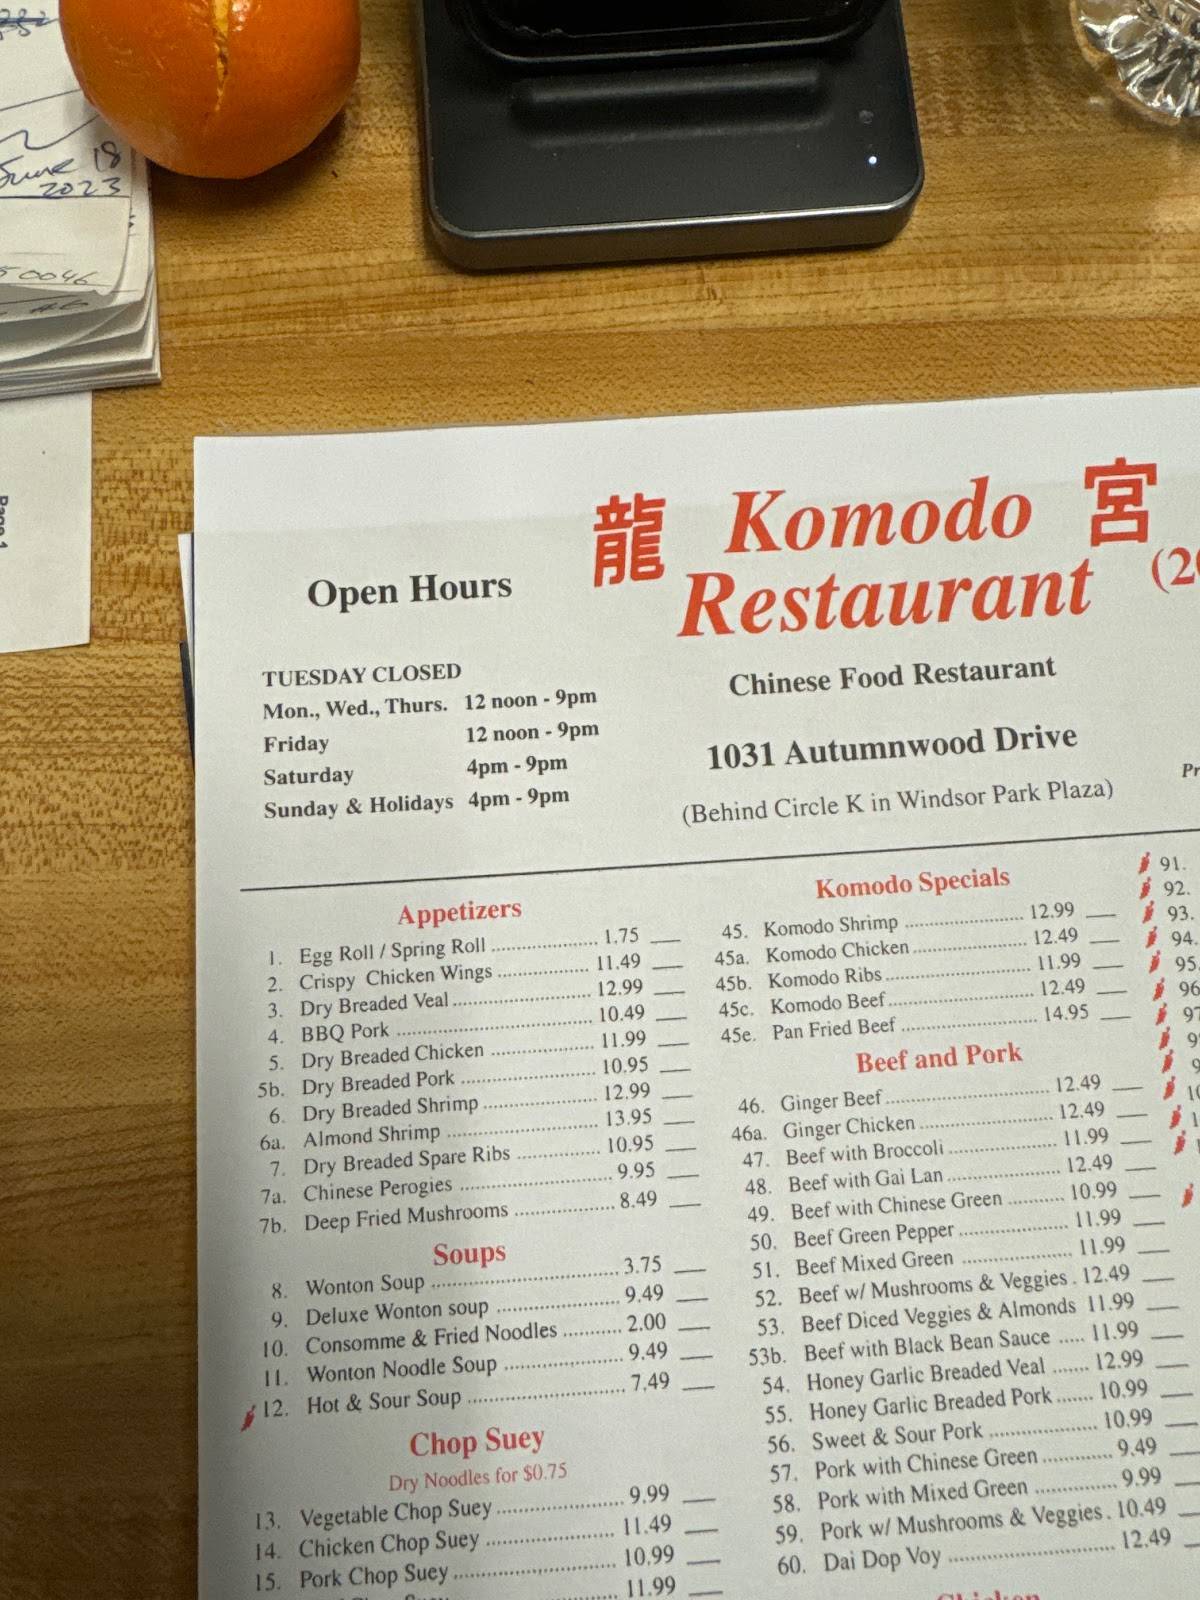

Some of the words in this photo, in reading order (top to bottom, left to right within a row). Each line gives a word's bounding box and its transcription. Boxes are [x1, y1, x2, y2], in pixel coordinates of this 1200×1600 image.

[40, 177, 121, 197] 2023
[723, 475, 1032, 553] Komodo
[1084, 457, 1157, 547] 宮
[593, 492, 666, 588] 龍
[1151, 547, 1200, 594] (2
[308, 579, 398, 614] Open
[409, 574, 512, 602] Hours
[677, 558, 1094, 637] Restaurant
[262, 667, 366, 687] TUESDAY
[372, 663, 461, 683] CLOSED
[729, 672, 831, 696] Chinese
[839, 664, 904, 690] Food
[912, 656, 1057, 685] Restaurant
[263, 703, 320, 721] Mon.,
[326, 699, 380, 718] Wed.,
[384, 698, 447, 714] Thurs.
[465, 694, 486, 710] 12
[491, 695, 538, 709] noon
[555, 689, 597, 709] 9pm
[264, 735, 329, 755] Friday
[467, 726, 488, 743] 12
[493, 728, 540, 742] noon
[557, 721, 599, 741] 9pm
[707, 742, 775, 770] 1031
[784, 728, 986, 765] Autumnwood
[993, 727, 1078, 752] Drive
[264, 766, 354, 786] Saturday
[467, 759, 509, 779] 4pm
[526, 755, 568, 776] 9pm
[265, 800, 338, 820] Sunday
[346, 798, 363, 814] &
[370, 795, 454, 814] Holidays
[468, 791, 510, 812] 4pm
[527, 788, 570, 808] 9pm
[682, 800, 768, 828] (Behind
[774, 796, 839, 818] Circle
[846, 794, 864, 813] K
[871, 793, 891, 812] in
[896, 788, 986, 809] Windsor
[992, 783, 1041, 804] Park
[1047, 779, 1113, 800] Plaza)
[816, 875, 912, 899] Komodo
[918, 867, 1010, 896] Specials
[1160, 856, 1186, 871] 91.
[1164, 881, 1190, 896] 92.
[398, 900, 522, 929] Appetizers
[722, 924, 748, 939] 45.
[764, 918, 834, 938] Komodo
[839, 915, 898, 933] Shrimp
[1031, 902, 1074, 919] 12.99
[1167, 905, 1194, 922] 93.
[270, 951, 282, 965] 1.
[300, 948, 333, 967] Egg
[340, 944, 373, 962] Roll
[380, 943, 386, 959] /
[391, 941, 446, 962] Spring
[452, 937, 485, 954] Roll
[606, 927, 638, 944] 1.75
[715, 950, 749, 966] 45a.
[766, 944, 837, 963] Komodo
[841, 940, 909, 958] Chicken
[1034, 927, 1078, 945] 12.49
[1171, 931, 1198, 947] 94.
[268, 976, 283, 993] 2.
[299, 973, 355, 992] Crispy
[366, 968, 435, 986] Chicken
[440, 964, 492, 983] Wings
[598, 953, 641, 971] 11.49
[268, 1029, 283, 1044] 4.
[302, 1024, 344, 1043] BBQ
[351, 1021, 389, 1039] Pork
[600, 1004, 645, 1022] 10.49
[269, 1055, 284, 1071] 5.
[302, 1053, 334, 1072] Dry
[341, 1046, 409, 1066] Breaded
[414, 1043, 484, 1061] Chicken
[603, 1030, 646, 1048] 11.99
[856, 1049, 908, 1073] Beef
[915, 1046, 958, 1069] and
[965, 1042, 1023, 1065] Pork
[260, 1135, 285, 1150] 6a.
[304, 1127, 373, 1147] Almond
[378, 1124, 440, 1143] Shrimp
[607, 1108, 652, 1126] 13.95
[731, 1125, 767, 1141] 46a.
[783, 1122, 841, 1141] Ginger
[846, 1116, 915, 1134] Chicken
[1060, 1101, 1104, 1119] 12.49
[260, 1218, 286, 1233] 7b.
[305, 1215, 350, 1233] Deep
[357, 1208, 401, 1227] Fried
[408, 1205, 508, 1223] Mushrooms
[620, 1190, 657, 1209] 8.49
[434, 1244, 506, 1268] Soups
[272, 1283, 287, 1298] 8.
[306, 1279, 373, 1295] Wonton
[381, 1274, 425, 1294] Soup
[625, 1255, 661, 1275] 3.75
[755, 1289, 782, 1308] 52.
[798, 1284, 839, 1304] Beef
[845, 1283, 865, 1300] w/
[871, 1280, 973, 1299] Mushrooms
[979, 1274, 995, 1292] &
[1000, 1270, 1067, 1293] Veggies
[1083, 1264, 1130, 1284] 12.49
[272, 1312, 287, 1328] 9.
[307, 1307, 369, 1325] Deluxe
[375, 1303, 442, 1320] Wonton
[448, 1301, 489, 1319] soup
[625, 1284, 663, 1303] 9.49
[265, 1399, 288, 1417] 12.
[308, 1397, 339, 1414] Hot
[346, 1394, 362, 1411] &
[369, 1392, 411, 1410] Sour
[417, 1389, 461, 1410] Soup
[631, 1371, 670, 1391] 7.49
[410, 1432, 477, 1459] Chop
[486, 1427, 544, 1454] Suey
[768, 1434, 795, 1454] 56.
[812, 1432, 866, 1450] Sweet
[872, 1427, 889, 1446] &
[895, 1426, 936, 1444] Sour
[942, 1421, 983, 1441] Pork
[1105, 1408, 1152, 1429] 10.99
[390, 1476, 418, 1493] Dry
[425, 1470, 489, 1488] Noodles
[496, 1467, 518, 1483] for
[524, 1462, 567, 1482] $0.75
[257, 1543, 280, 1560] 14.
[299, 1537, 374, 1558] Chicken
[381, 1534, 429, 1556] Chop
[436, 1530, 479, 1552] Suey
[624, 1514, 671, 1536] 11.49
[778, 1555, 805, 1575] 60.
[824, 1551, 855, 1572] Dai
[862, 1550, 901, 1572] Dop
[906, 1546, 941, 1569] Voy
[1123, 1527, 1171, 1549] 12.49
